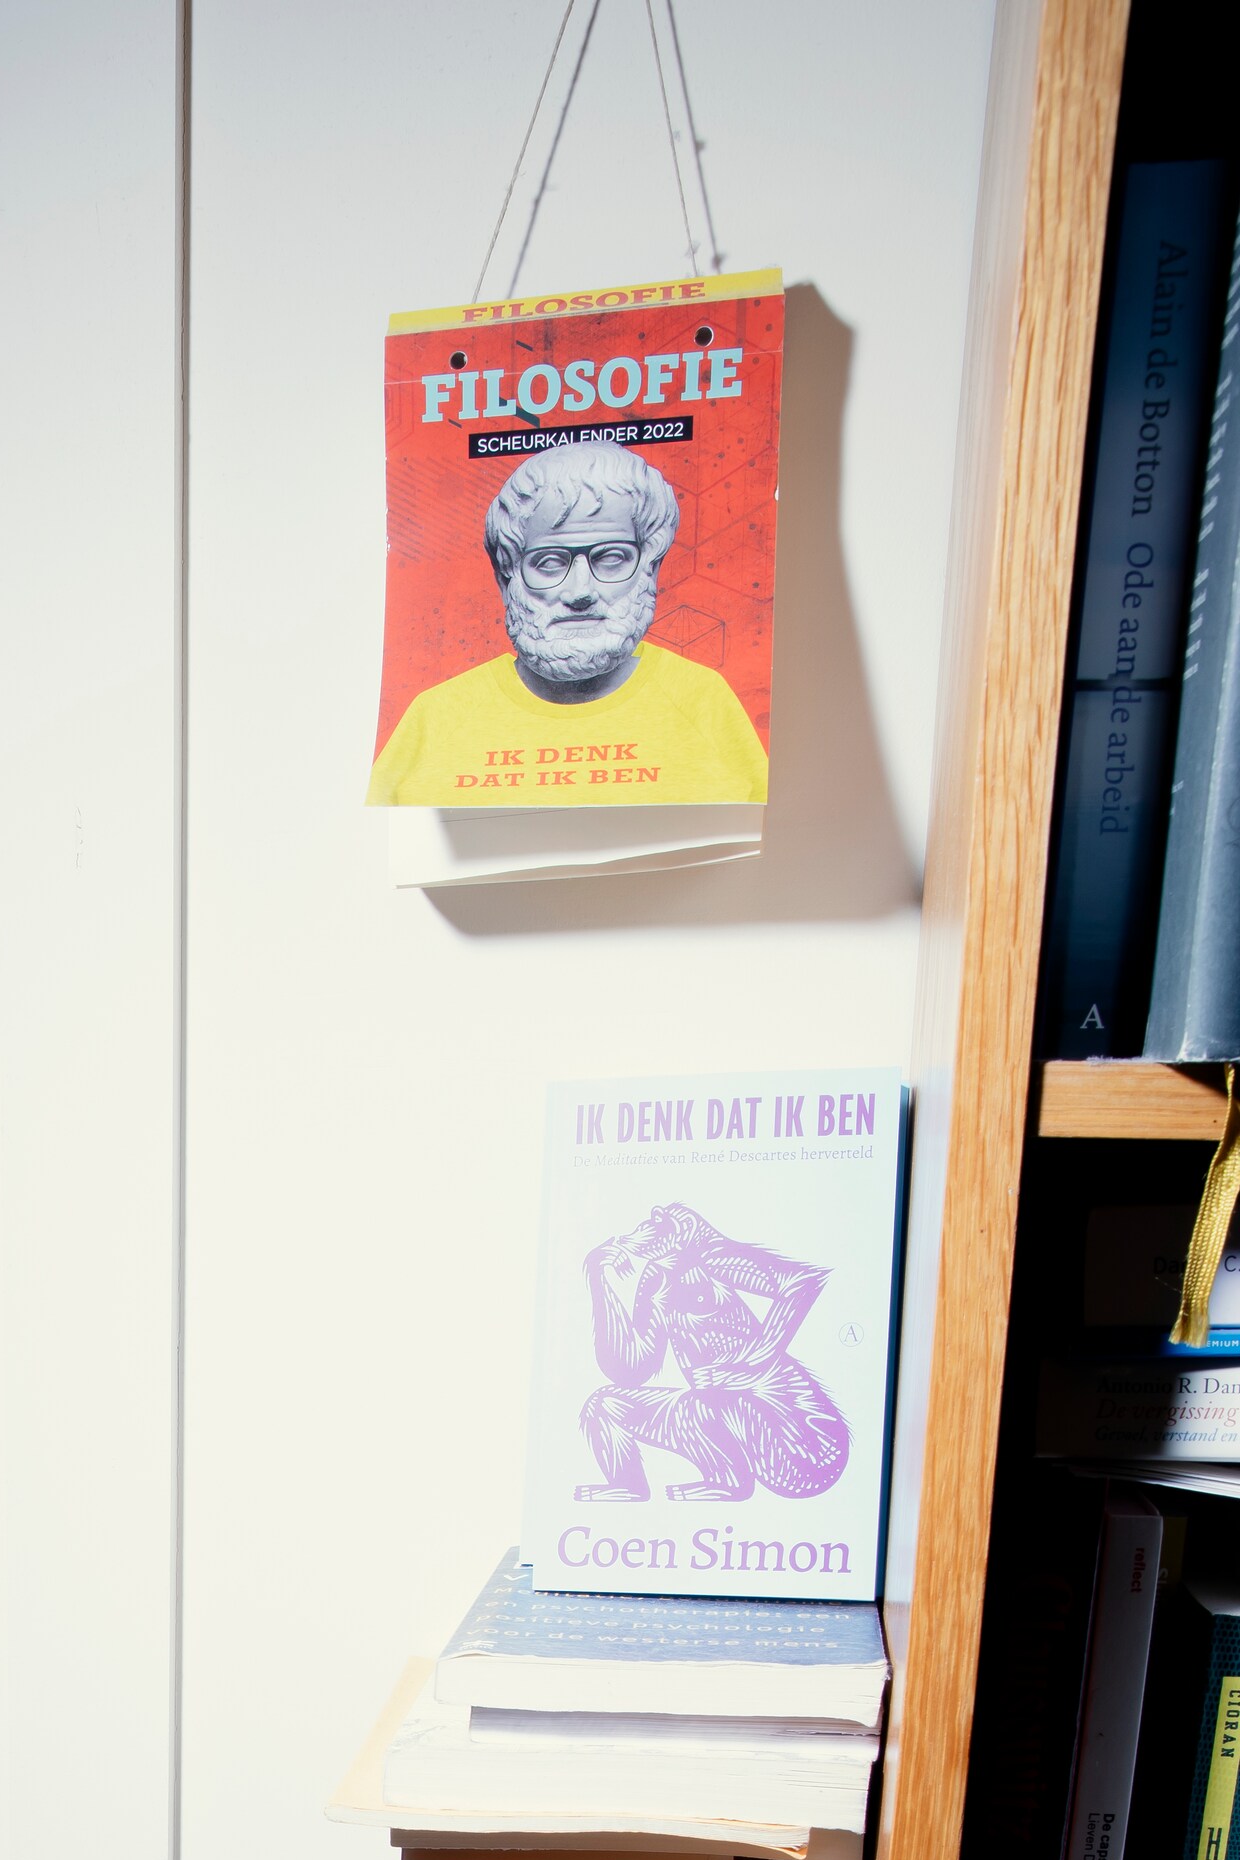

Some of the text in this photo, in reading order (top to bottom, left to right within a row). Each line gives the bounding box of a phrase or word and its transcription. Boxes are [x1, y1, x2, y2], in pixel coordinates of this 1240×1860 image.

[462, 281, 706, 322] FILOSOFIE
[421, 347, 744, 424] FILOSOFIE
[1130, 240, 1188, 517] Alain de Botton
[477, 421, 684, 453] SCHEURKALENDER 2022
[1122, 541, 1155, 609] Ode
[1113, 618, 1142, 679] aan
[485, 743, 639, 766] IK DENK
[454, 767, 662, 788] DAT IK BEN
[1099, 732, 1135, 836] arbeid
[575, 1093, 876, 1145] IK DENK DAT IK BEN
[594, 1151, 659, 1167] Meditaties
[662, 1154, 686, 1165] van
[691, 1149, 725, 1164] René
[729, 1146, 797, 1163] Descartes
[801, 1145, 874, 1161] herverteld
[1179, 1377, 1197, 1393] R.
[557, 1525, 852, 1574] Coen Simon
[1131, 1546, 1147, 1594] reflect
[548, 1632, 583, 1640] de
[632, 1622, 826, 1635] psychologie
[1084, 1812, 1101, 1851] Lieven
[1100, 1812, 1114, 1833] De
